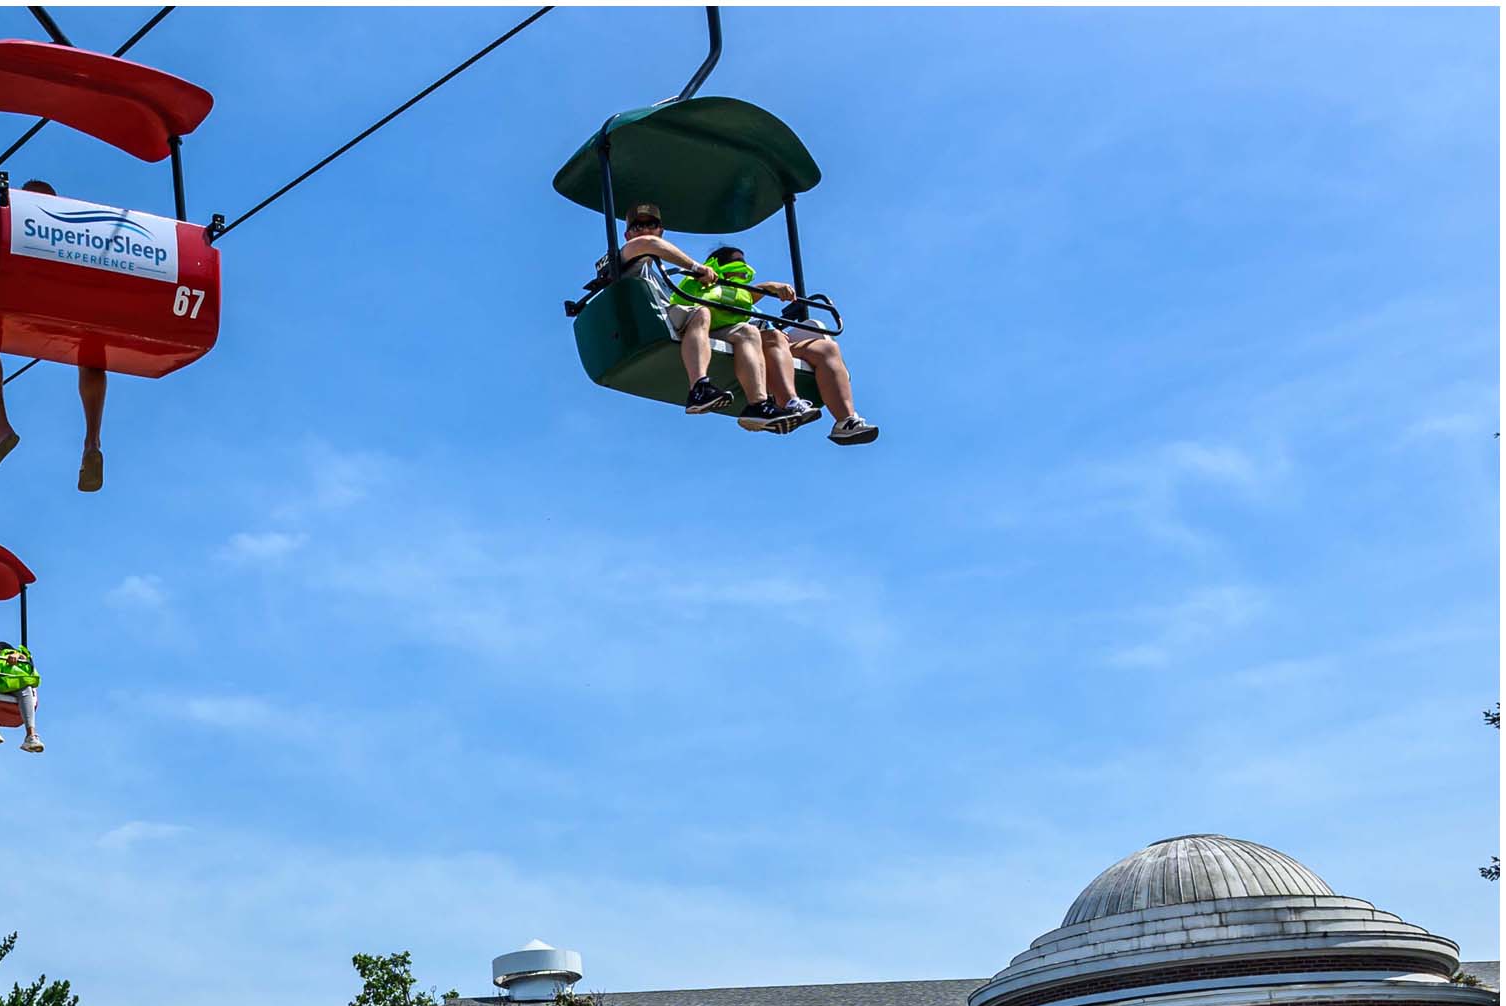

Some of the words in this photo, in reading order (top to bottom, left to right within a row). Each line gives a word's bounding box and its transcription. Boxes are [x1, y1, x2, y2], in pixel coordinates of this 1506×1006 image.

[24, 218, 167, 265] SuperiorSleep
[58, 249, 135, 271] EXPERIENCE
[172, 286, 205, 320] 67
